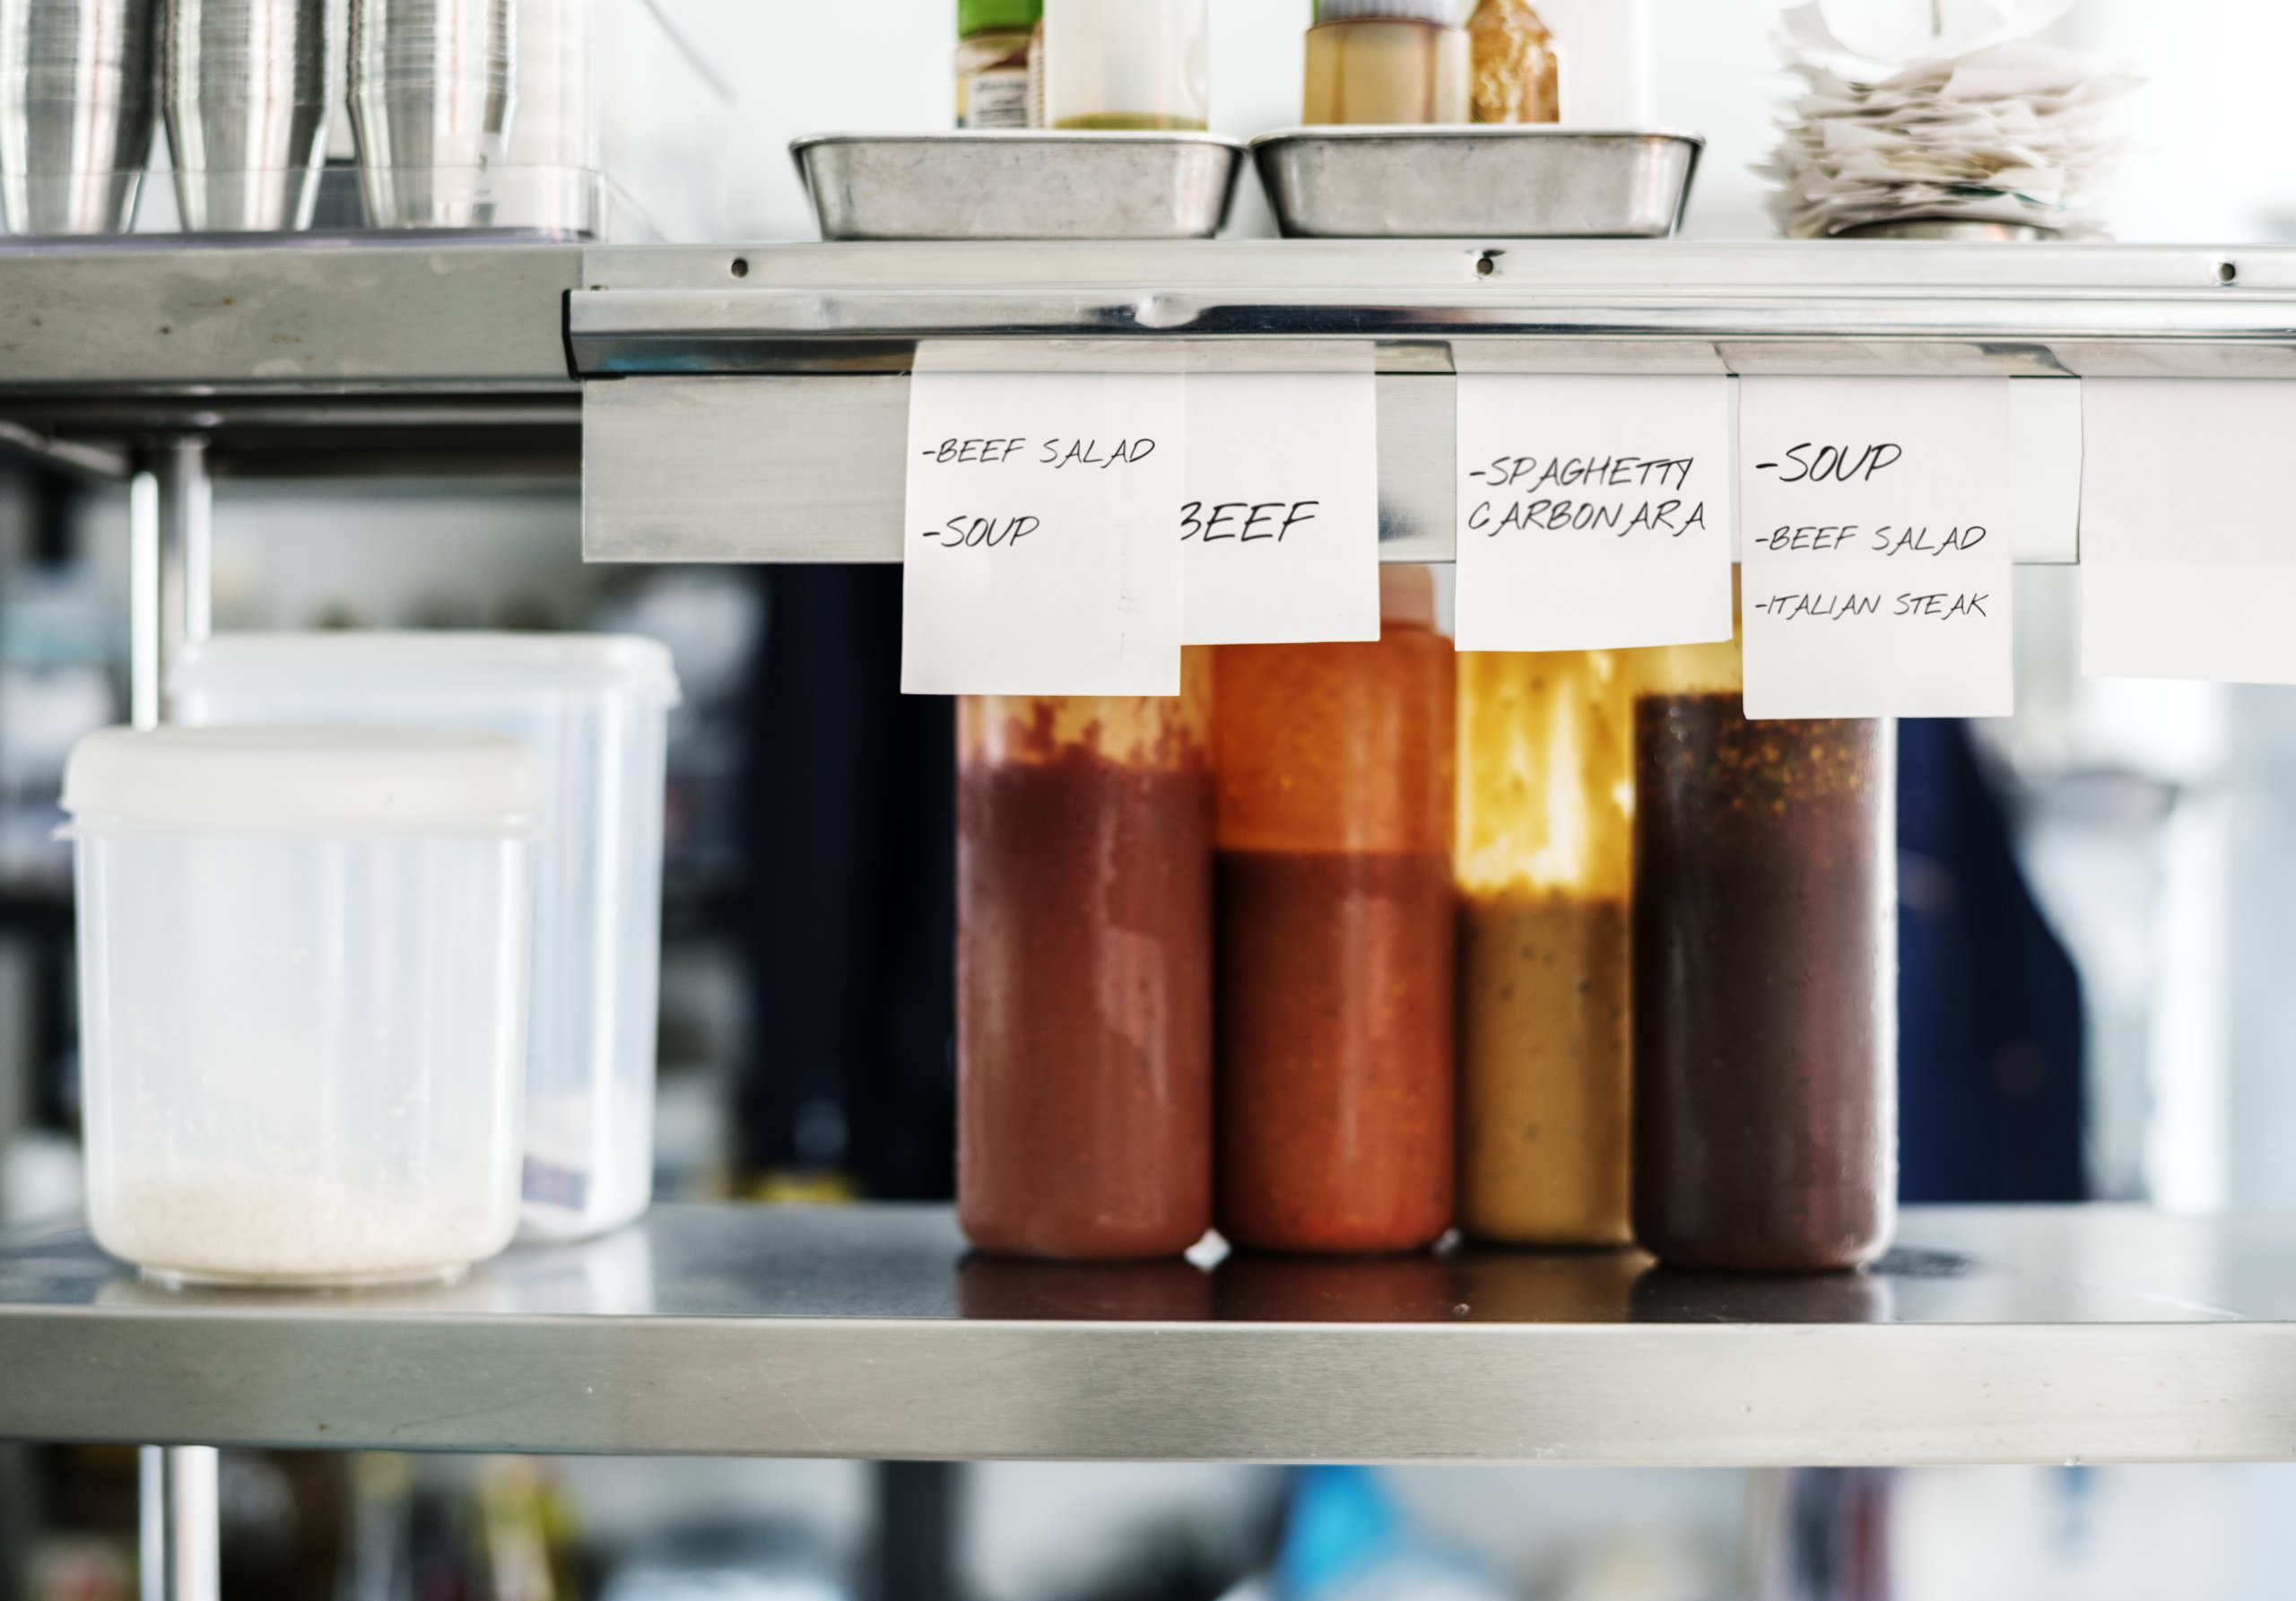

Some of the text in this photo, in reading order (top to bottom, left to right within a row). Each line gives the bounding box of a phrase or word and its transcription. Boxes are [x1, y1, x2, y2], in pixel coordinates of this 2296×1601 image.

[1039, 438, 1156, 469] SALAD
[1468, 499, 1706, 537] CARBONARA
[1872, 526, 1987, 557] SALAD
[1893, 593, 1990, 621] STEAK
